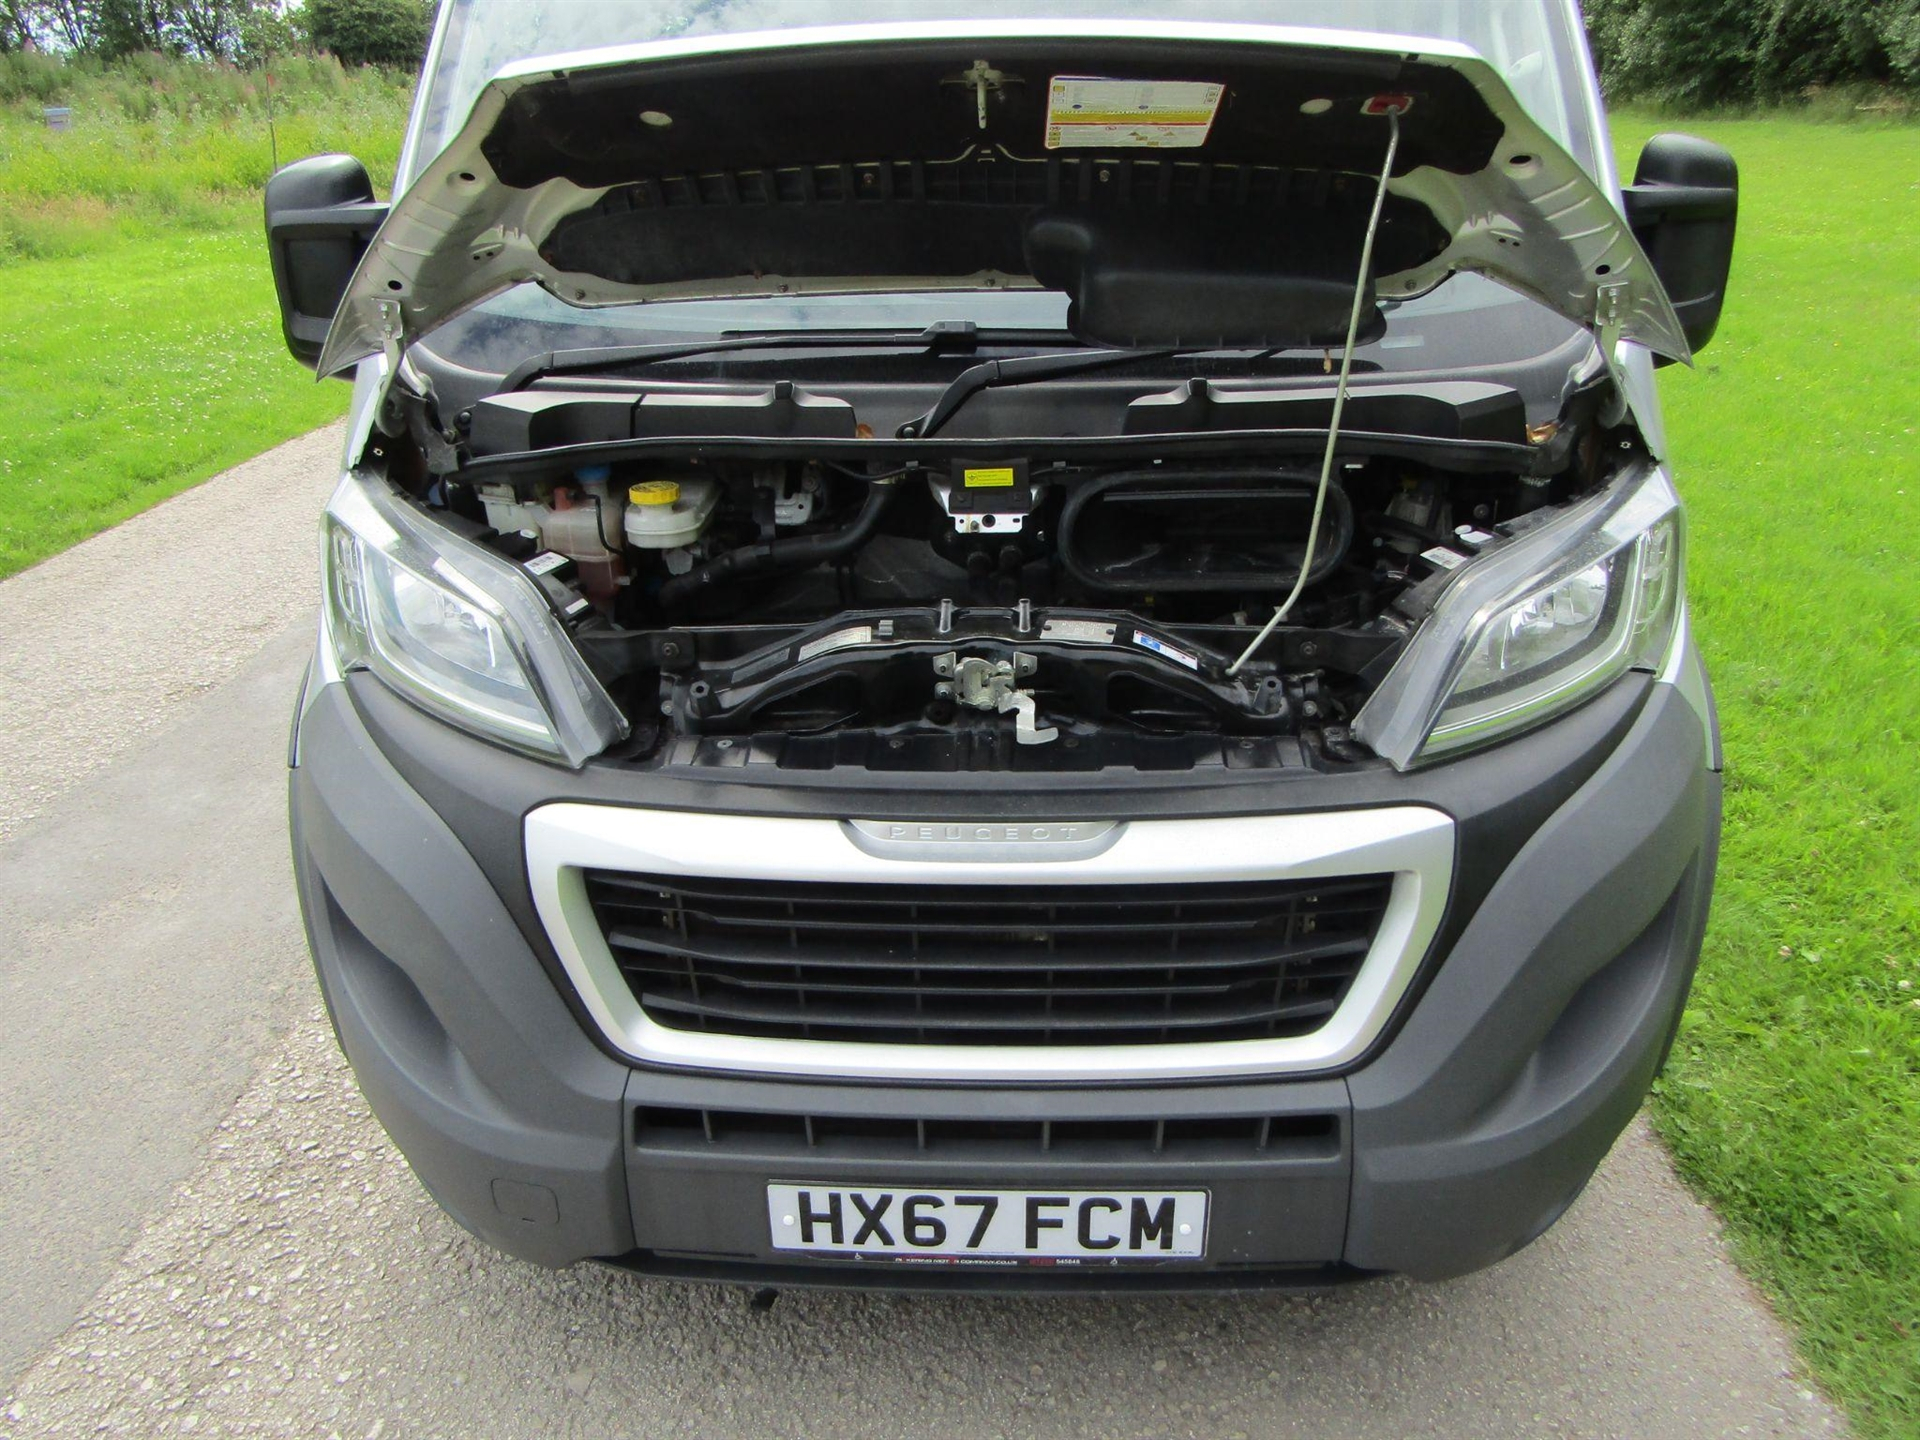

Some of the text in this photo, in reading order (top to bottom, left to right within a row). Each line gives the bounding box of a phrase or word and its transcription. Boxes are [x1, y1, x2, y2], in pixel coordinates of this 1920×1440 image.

[889, 826, 1078, 840] PEUGEOT
[797, 1190, 1176, 1250] HX67 FCM
